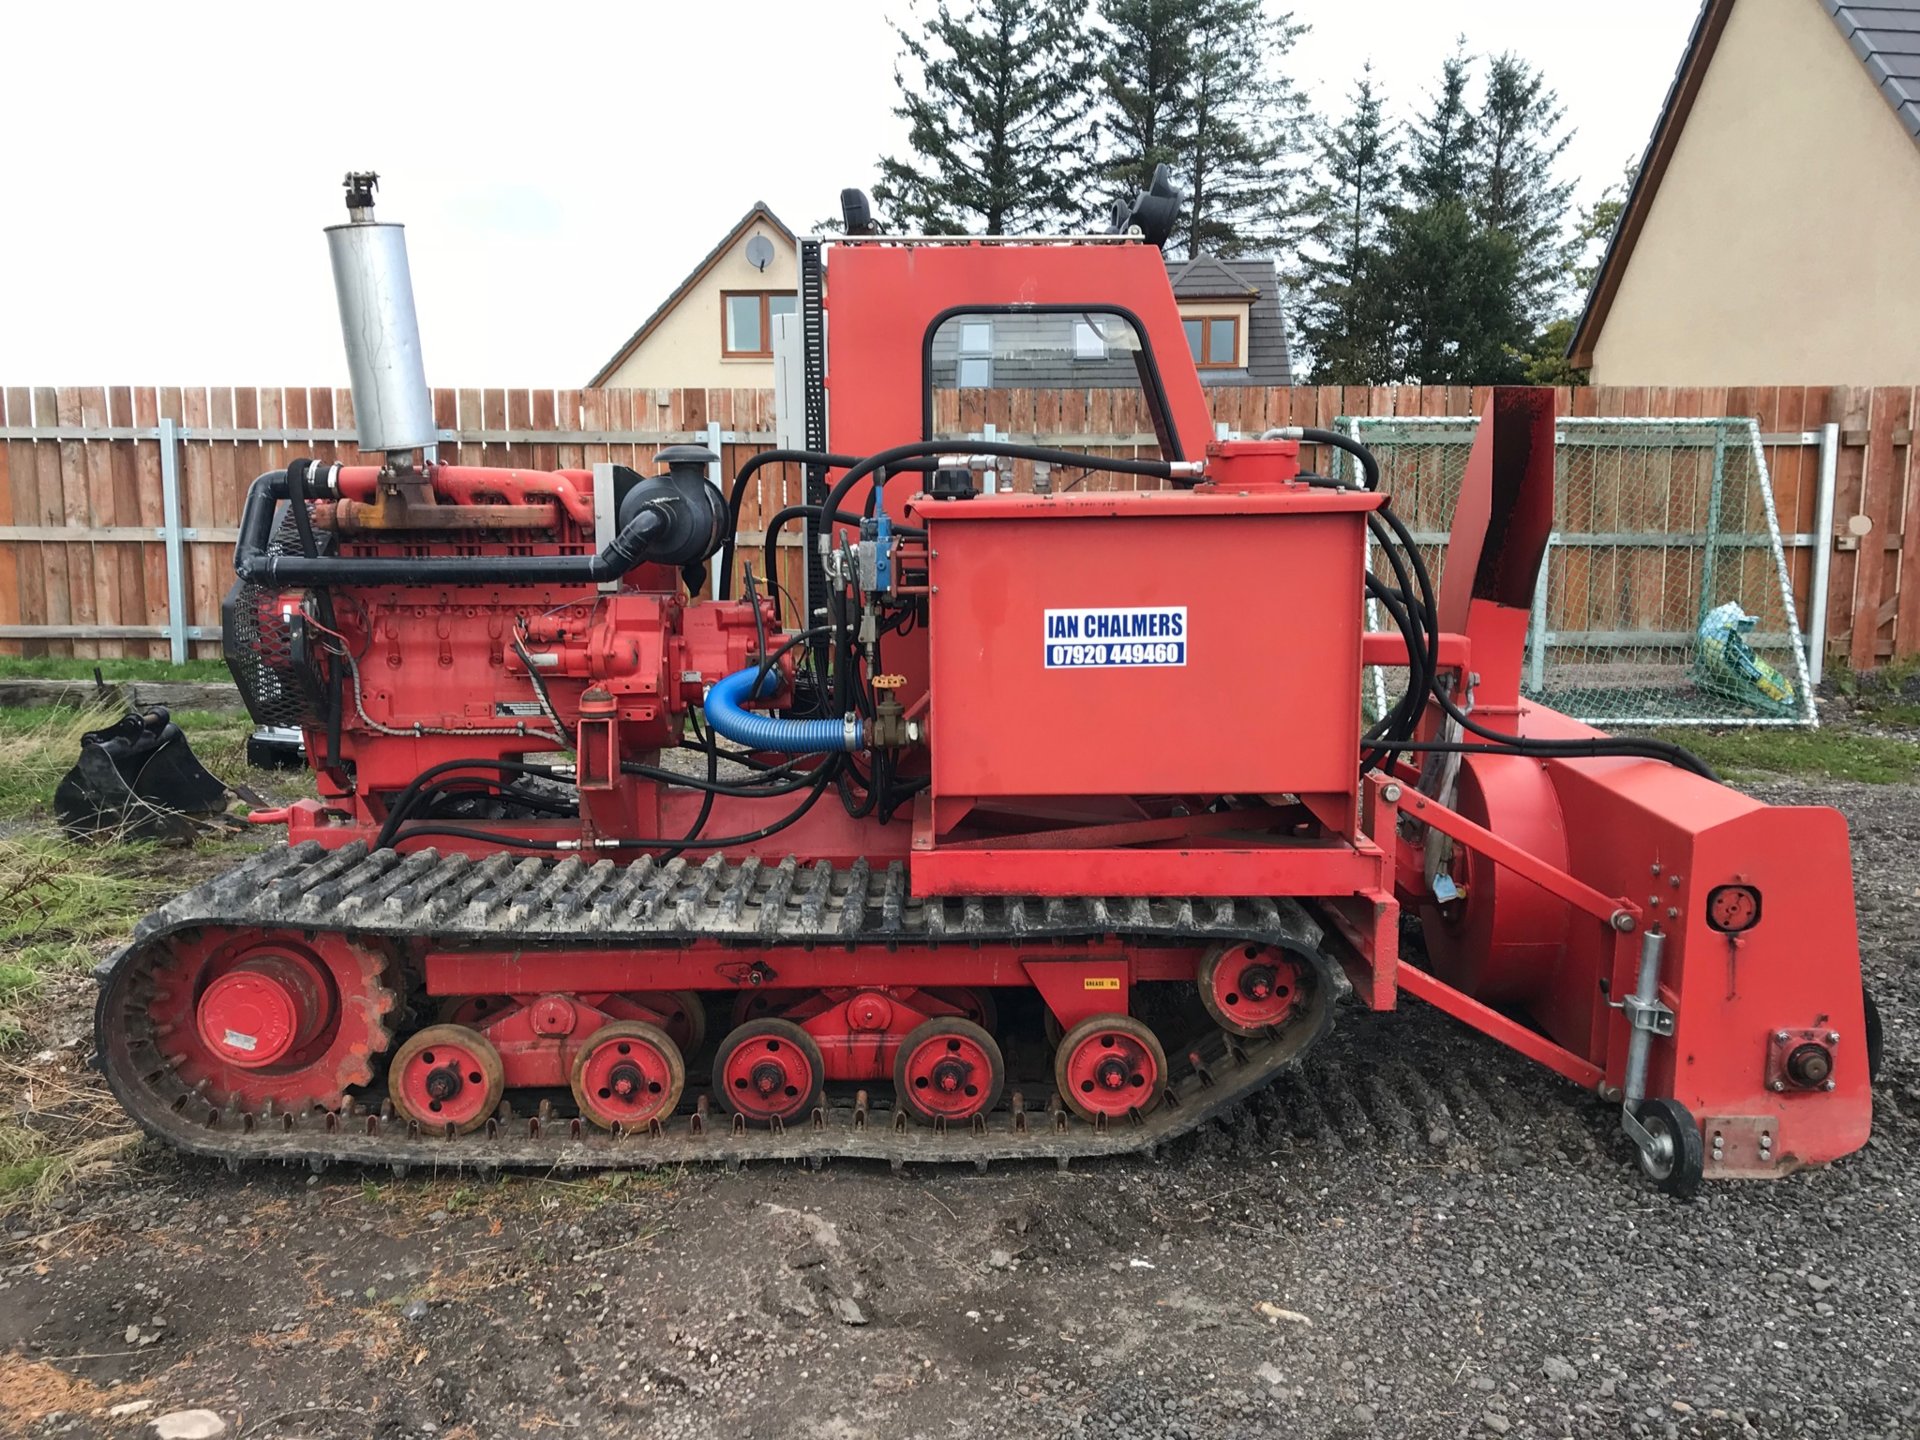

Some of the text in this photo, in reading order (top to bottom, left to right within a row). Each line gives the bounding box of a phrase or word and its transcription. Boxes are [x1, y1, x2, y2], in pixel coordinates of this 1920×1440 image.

[1048, 613, 1183, 638] IAN CHALMERS
[1052, 643, 1179, 665] 07920 449460
